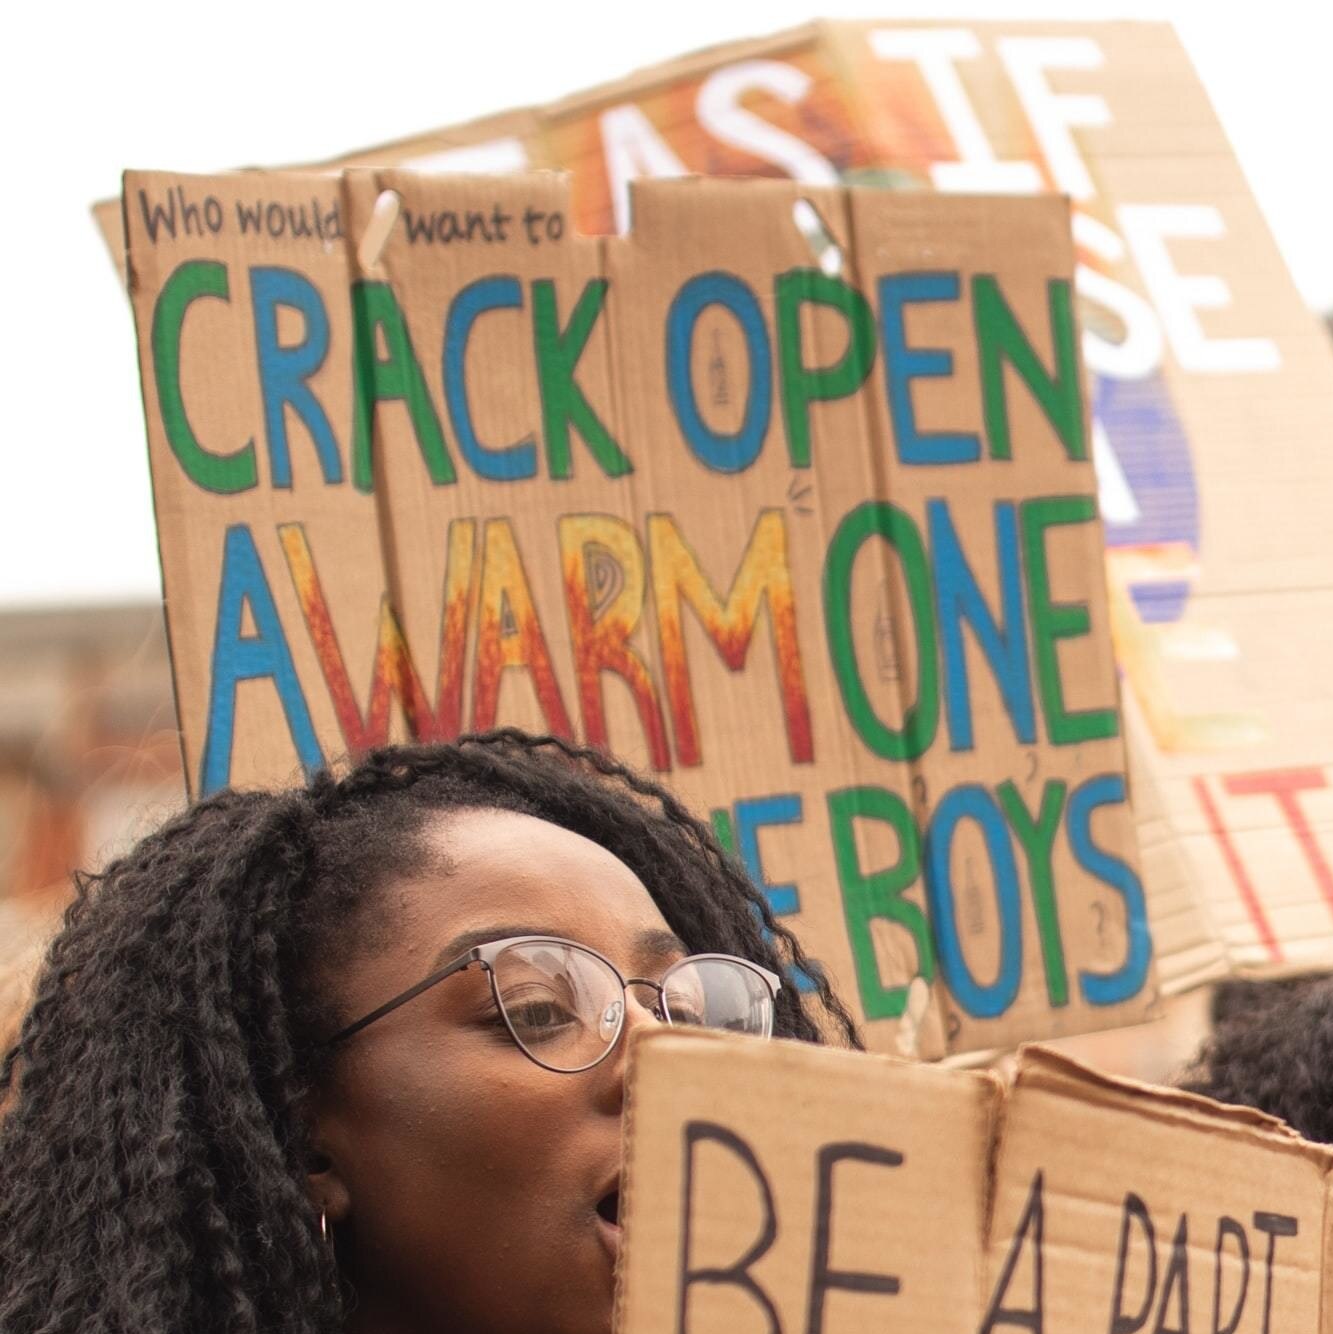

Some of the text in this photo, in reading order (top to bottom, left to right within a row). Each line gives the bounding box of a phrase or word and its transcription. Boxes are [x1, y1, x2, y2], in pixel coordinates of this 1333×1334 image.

[139, 184, 566, 245] Who would want to
[868, 26, 1113, 196] IF
[150, 259, 635, 496] CRACK
[664, 266, 1090, 476] OPEN
[201, 522, 329, 797] A
[276, 505, 816, 774] WARM
[822, 496, 1122, 761] ONE
[826, 771, 1153, 1022] BOYS
[1190, 764, 1329, 965] IT
